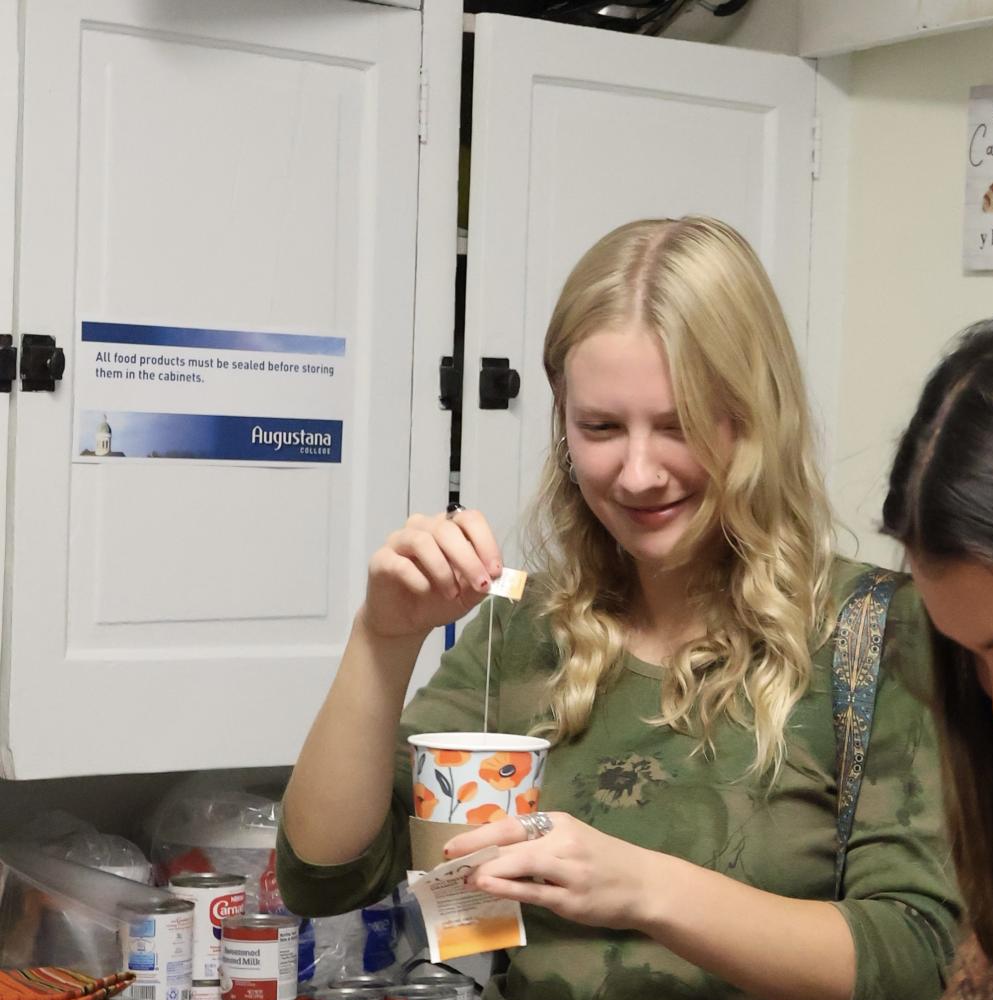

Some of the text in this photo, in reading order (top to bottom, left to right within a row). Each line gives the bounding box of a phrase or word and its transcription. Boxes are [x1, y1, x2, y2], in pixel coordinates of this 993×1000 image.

[979, 233, 988, 250] y
[95, 351, 335, 377] All food products must be sealed before storing
[95, 367, 205, 383] them in the cabinets.
[251, 425, 332, 451] Augustana
[300, 446, 331, 455] COLLEGE
